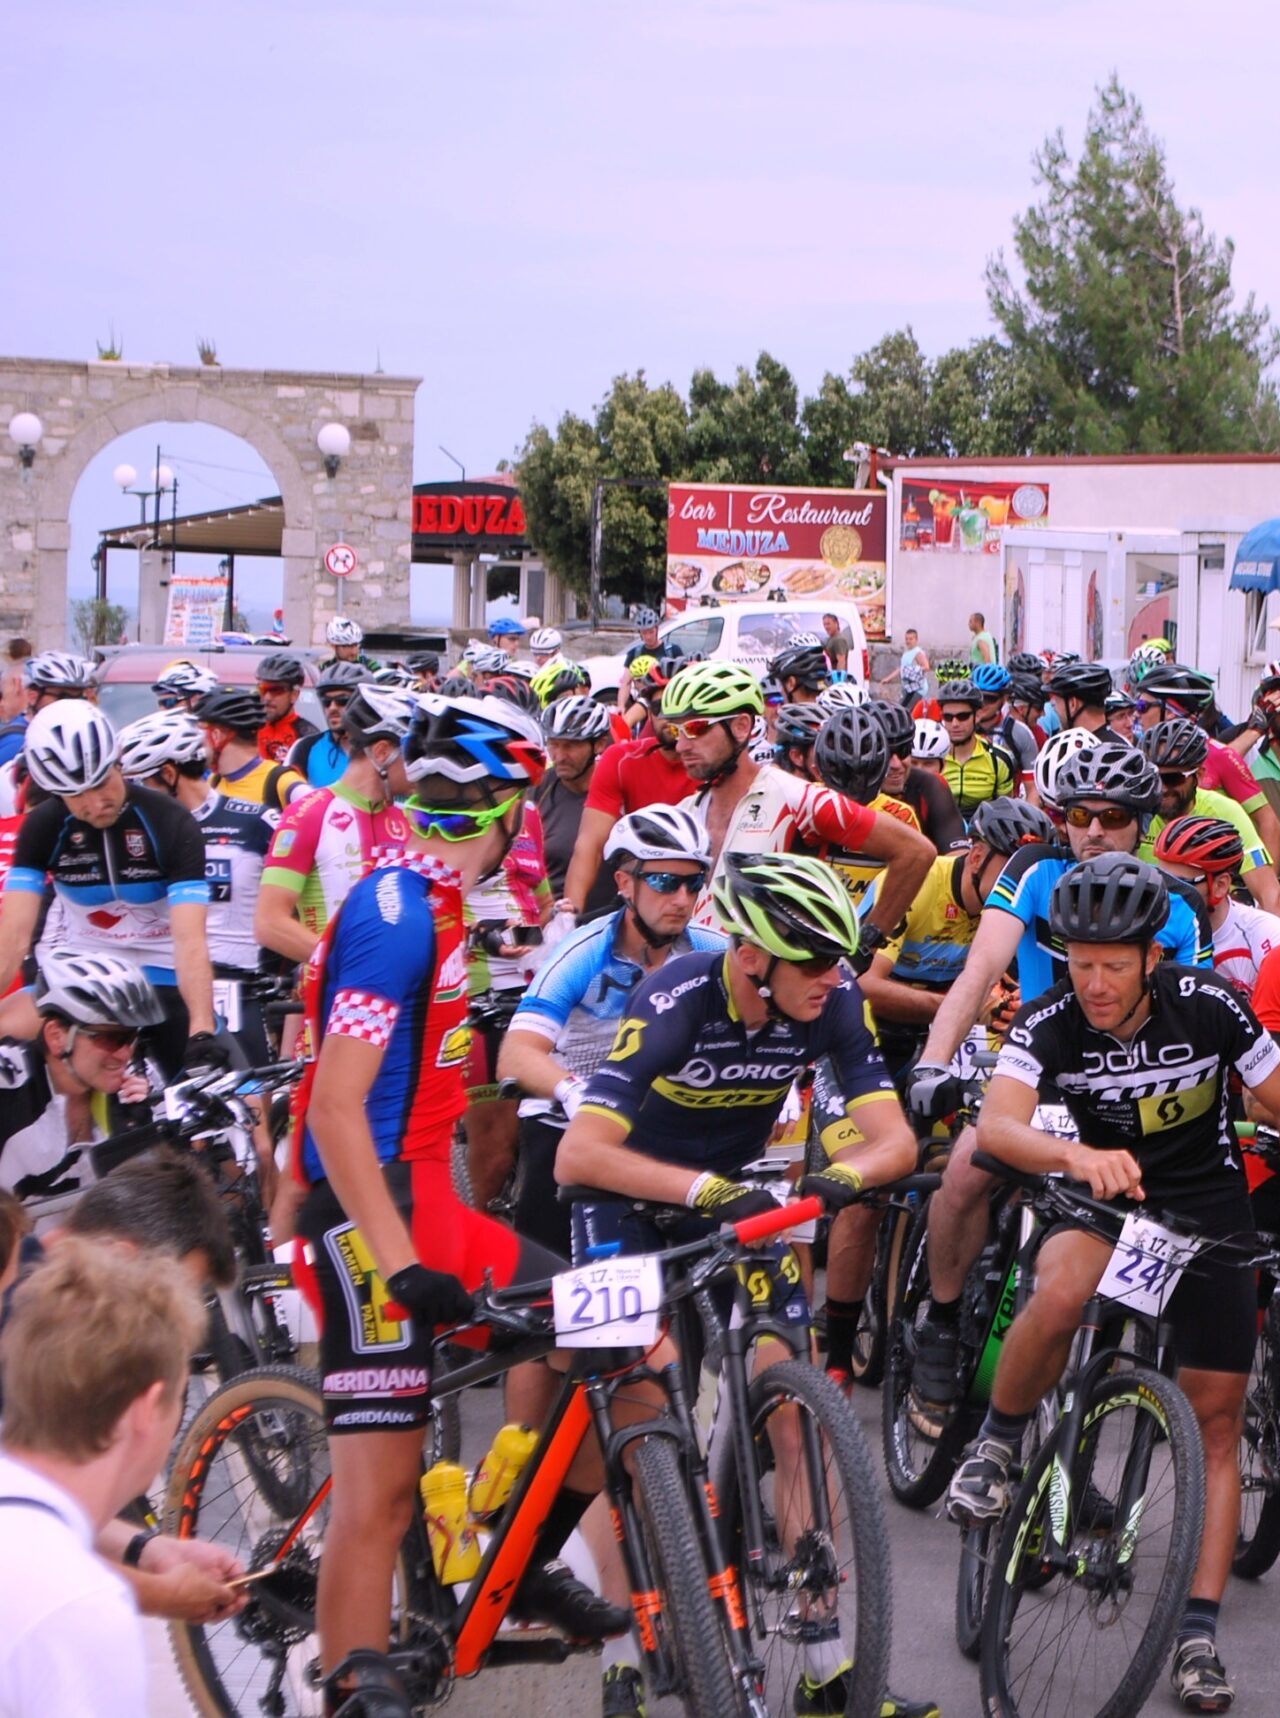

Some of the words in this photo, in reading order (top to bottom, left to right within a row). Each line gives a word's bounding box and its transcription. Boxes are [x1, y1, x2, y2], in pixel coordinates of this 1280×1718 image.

[680, 495, 716, 520] bar
[747, 493, 873, 527] Restaurant
[697, 528, 790, 557] MEDUZA
[671, 975, 710, 998] ORICA
[1198, 983, 1255, 1035] SCOTT
[720, 1064, 806, 1081] ORICA
[1150, 1235, 1168, 1257] 17.
[336, 1234, 365, 1287] KAMEN
[589, 1268, 613, 1284] 17.
[570, 1285, 643, 1325] 210
[361, 1303, 378, 1345] PAZIN
[323, 1368, 429, 1392] MERIDIANA
[333, 1409, 415, 1426] MERIDIANA
